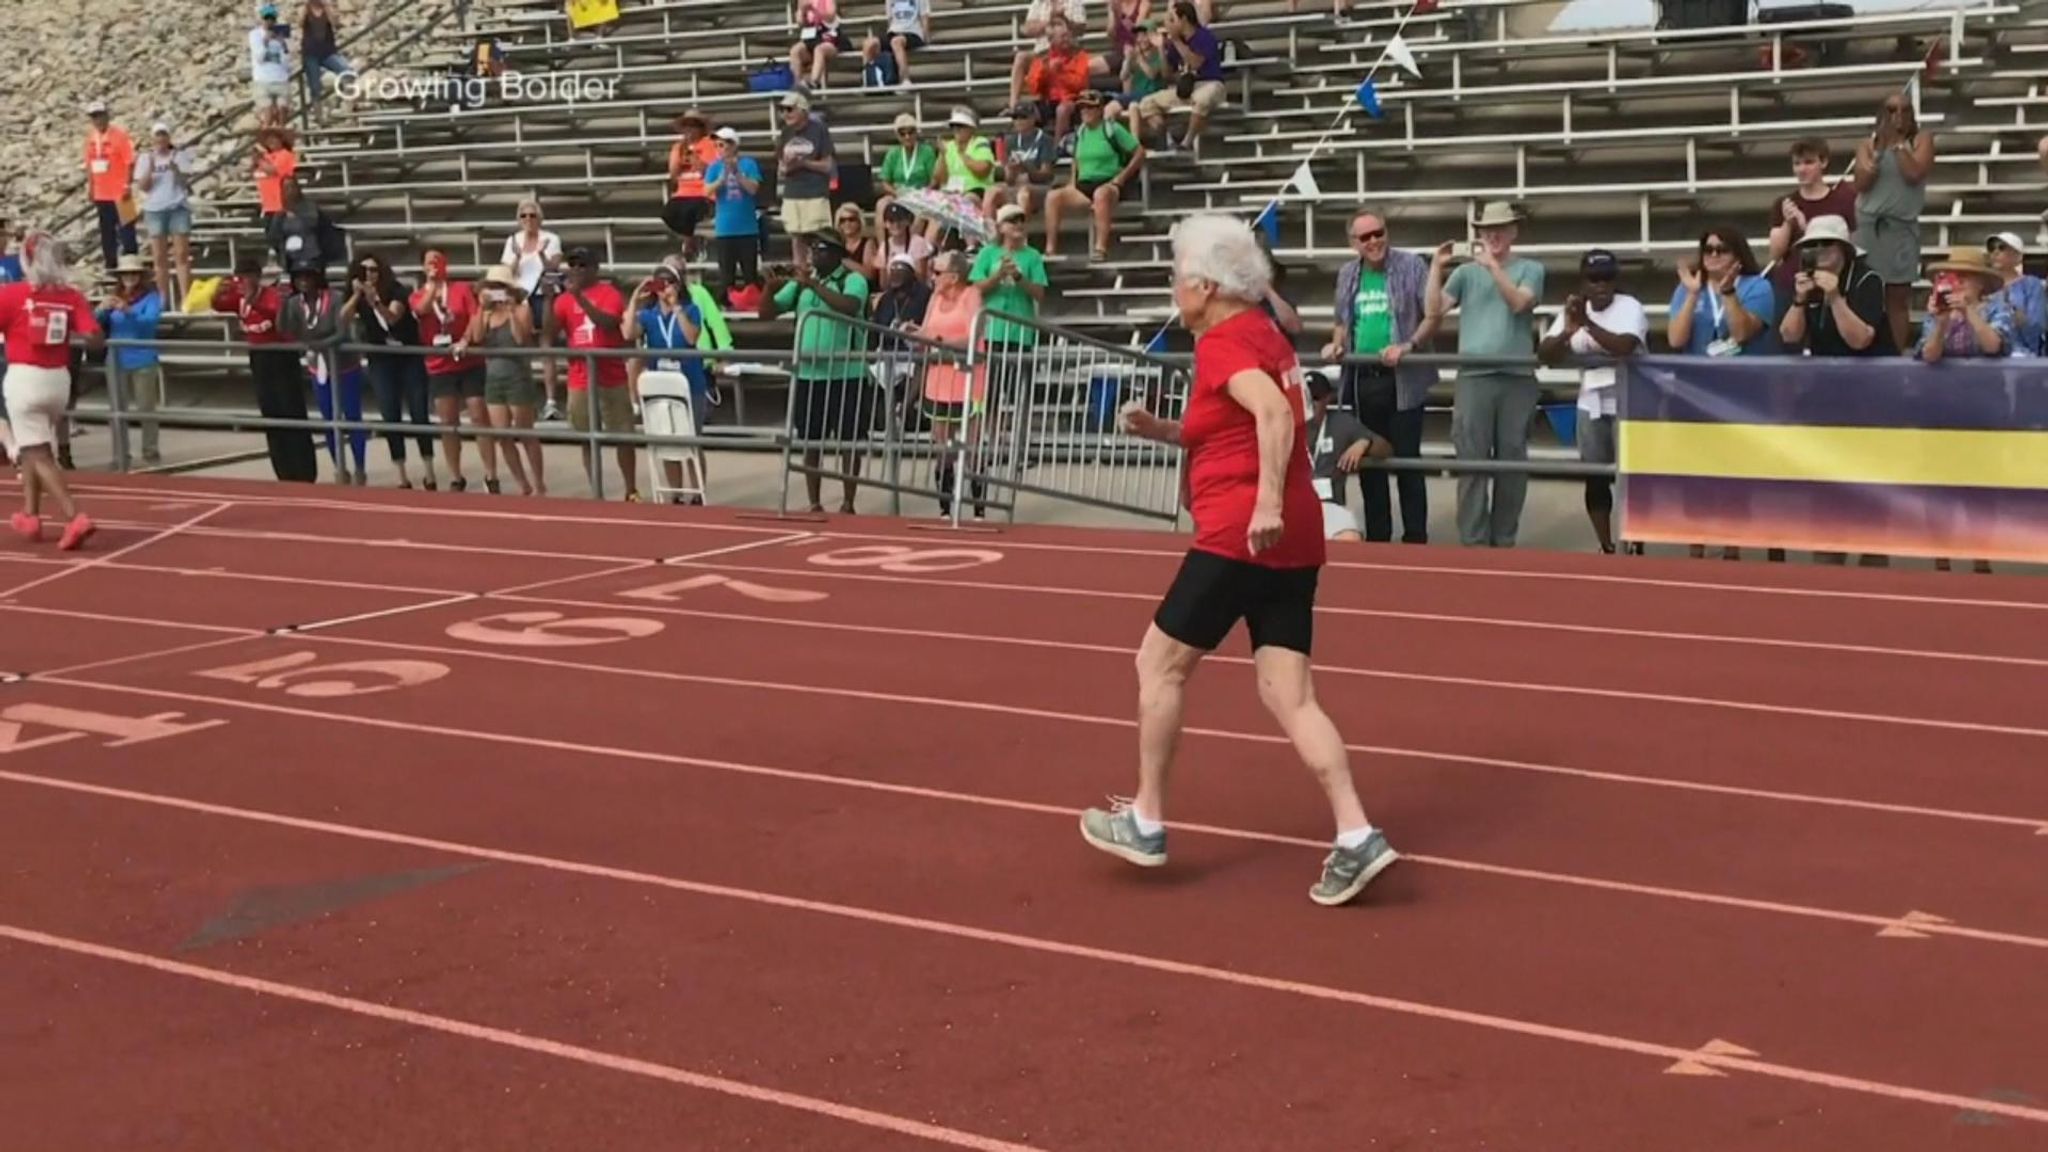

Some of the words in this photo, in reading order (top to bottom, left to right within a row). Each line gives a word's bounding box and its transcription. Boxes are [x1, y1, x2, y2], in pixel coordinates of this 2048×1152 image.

[806, 546, 1004, 572] 8
[614, 573, 830, 602] 7
[445, 611, 665, 646] 6
[188, 651, 451, 697] 5
[0, 702, 230, 753] 4
